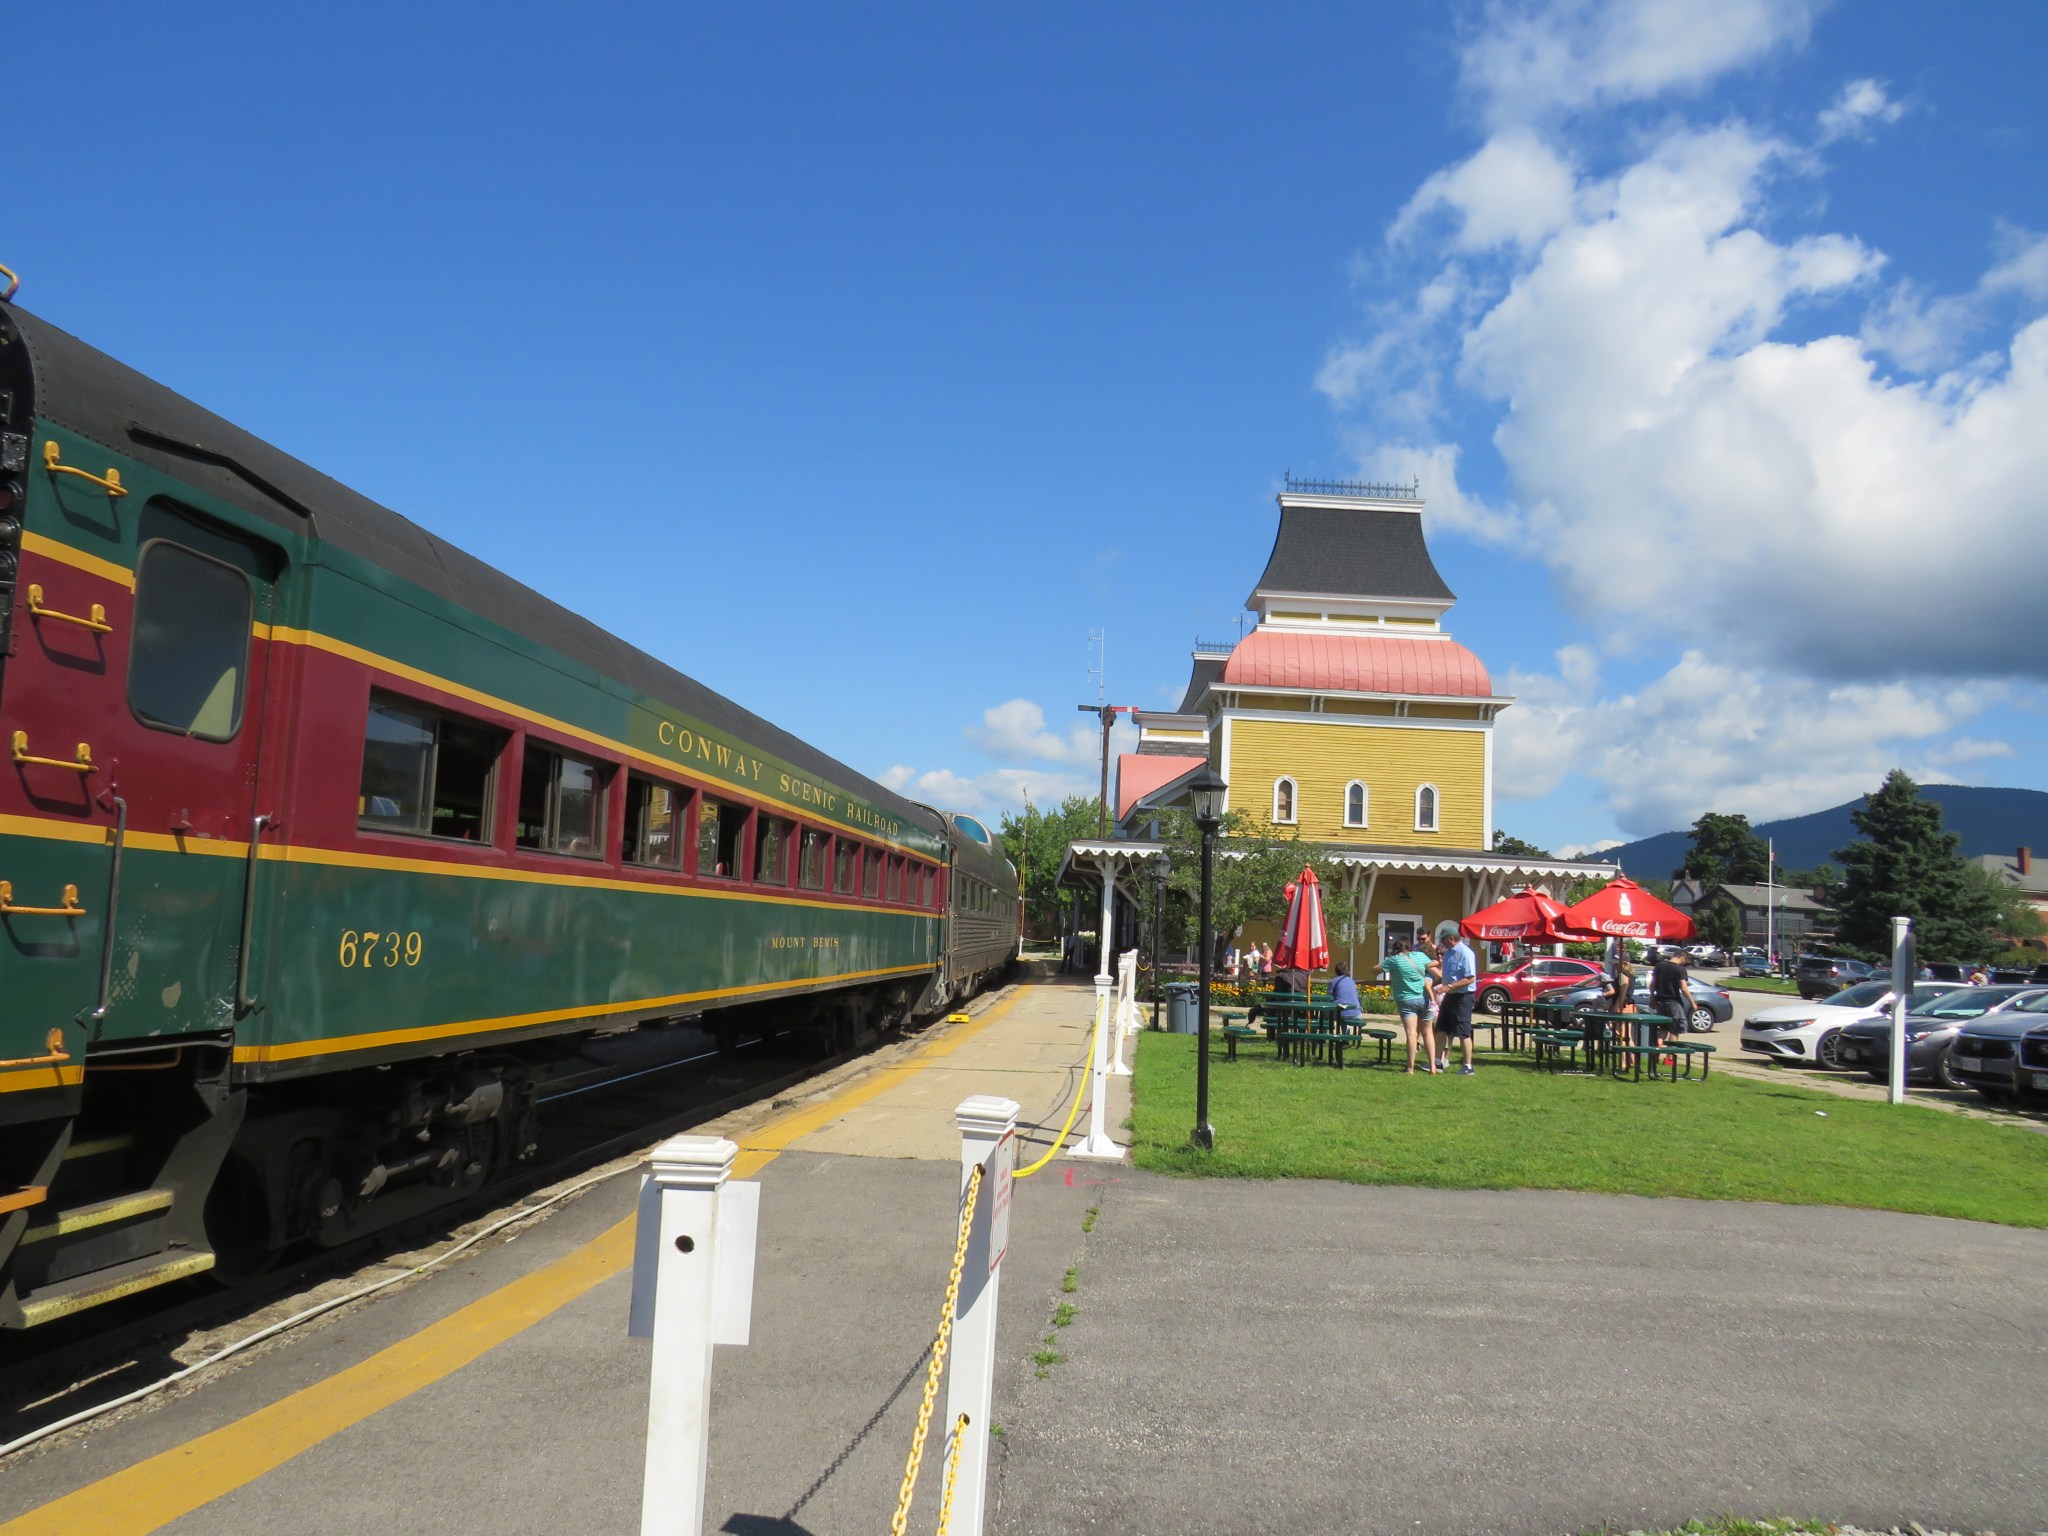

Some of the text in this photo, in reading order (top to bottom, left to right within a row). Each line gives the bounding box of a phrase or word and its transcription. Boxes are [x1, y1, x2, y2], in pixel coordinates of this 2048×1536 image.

[659, 721, 898, 836] CONWAY SCENIC RAILROAD
[1602, 919, 1649, 936] Coca-Cola
[340, 930, 422, 968] 6739
[771, 937, 805, 949] MOUNT
